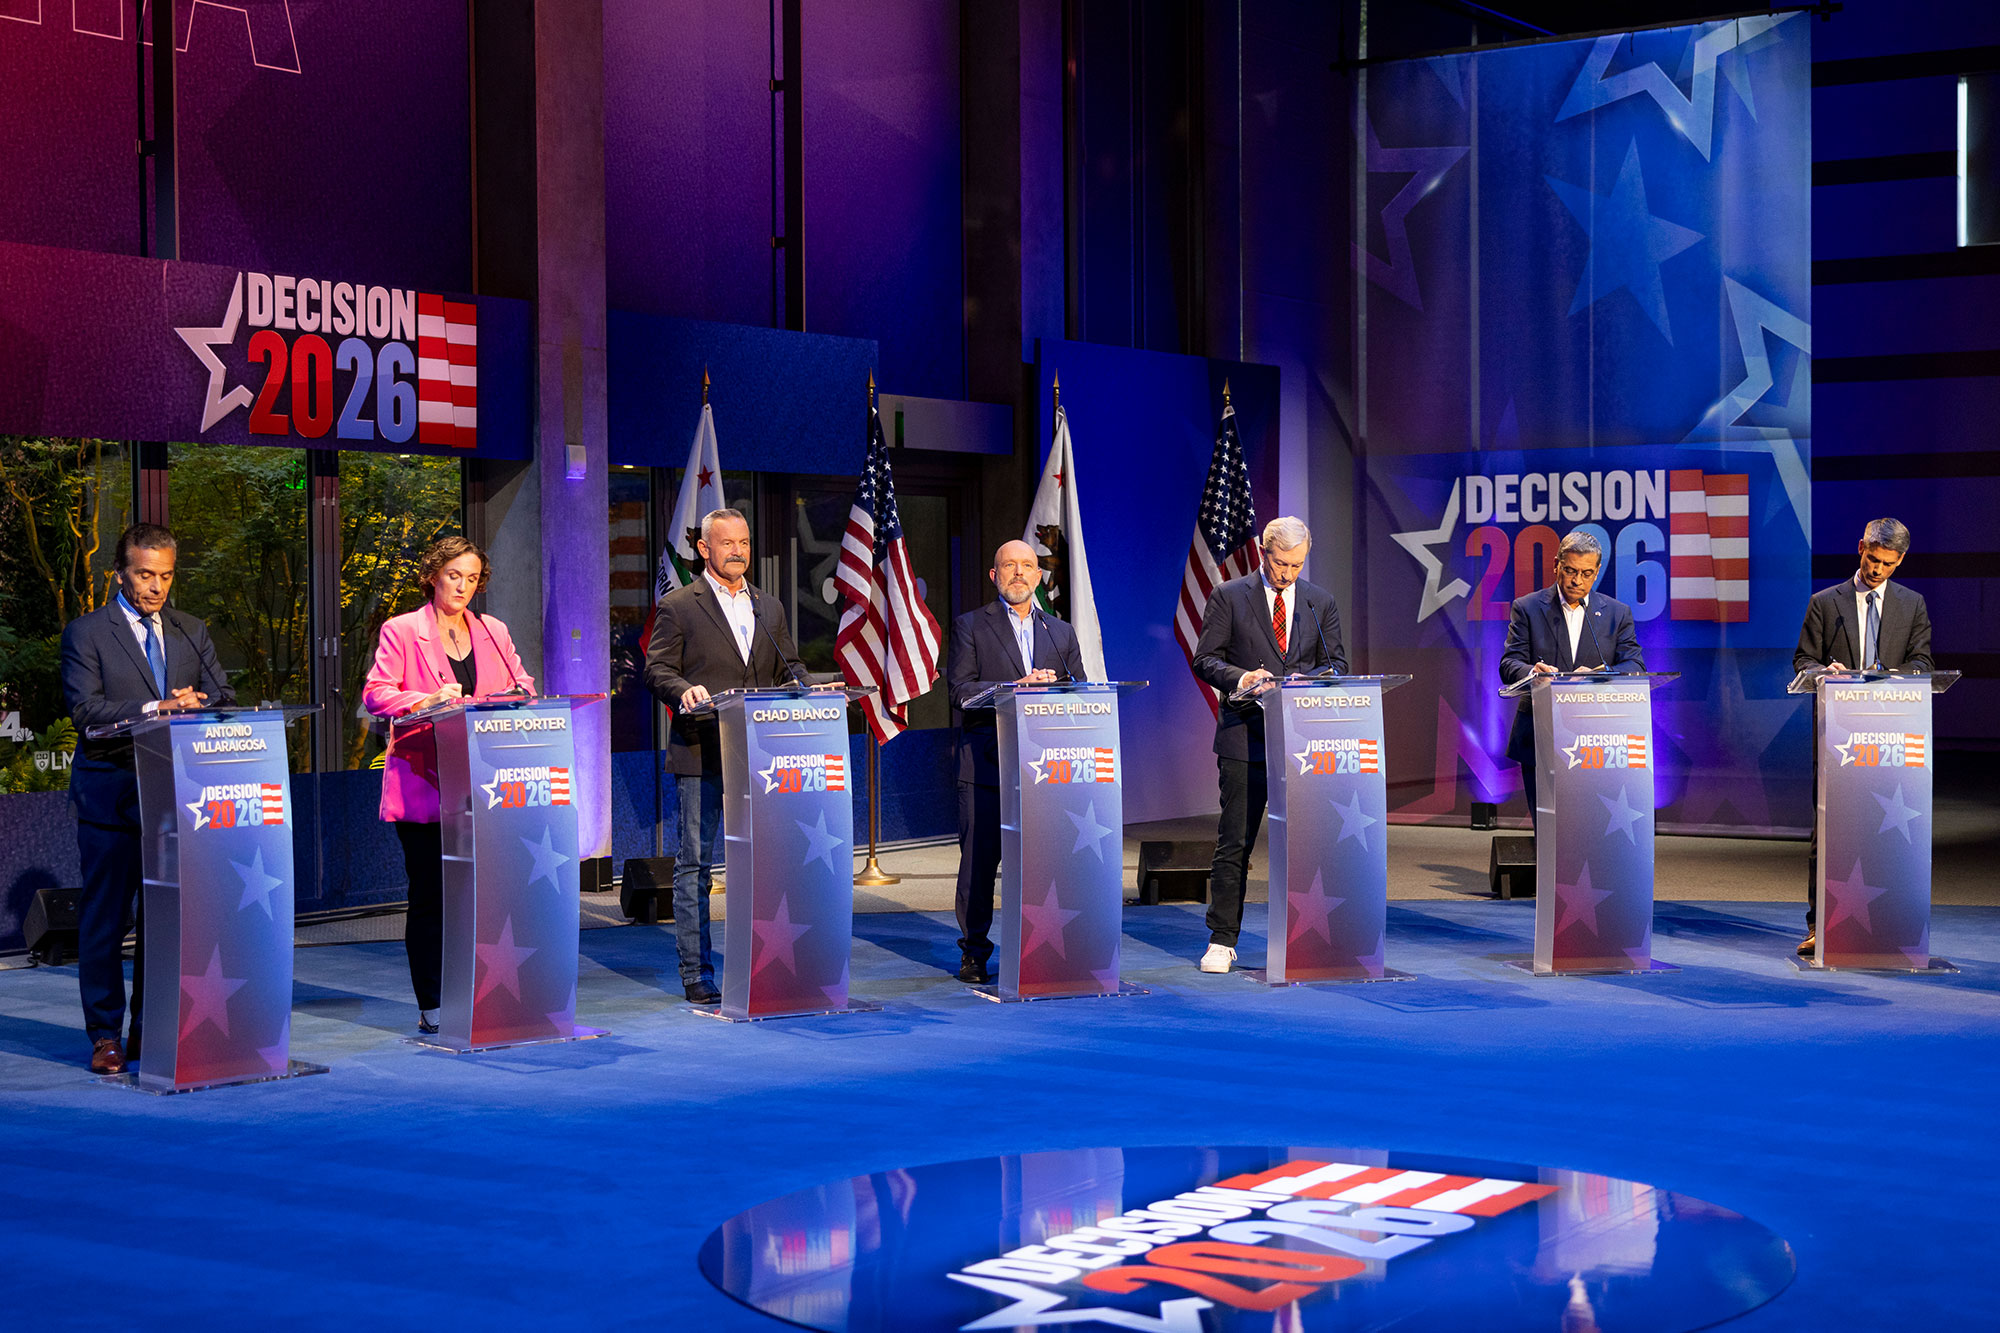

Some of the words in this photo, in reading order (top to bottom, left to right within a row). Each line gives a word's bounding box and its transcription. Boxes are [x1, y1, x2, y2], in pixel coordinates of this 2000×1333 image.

[248, 272, 416, 341] DECISION
[248, 330, 417, 443] 2026
[1465, 469, 1666, 524] DECISION
[1293, 696, 1321, 708] TOM
[1324, 695, 1371, 708] STEYER
[1555, 693, 1594, 703] XAVIER
[1596, 692, 1647, 703] BECERRA
[1834, 690, 1870, 701] MATT
[1873, 690, 1922, 701] MAHAN
[753, 709, 789, 722] CHAD
[792, 707, 840, 721] BIANCO
[1024, 703, 1064, 715] STEVE
[1066, 702, 1111, 715] HILTON
[205, 725, 252, 738] ANTONIO
[474, 718, 512, 733] KATIE
[514, 717, 566, 731] PORTER
[192, 738, 267, 754] VILLARAIGOSA
[1311, 739, 1359, 752] DECISION
[1580, 734, 1627, 746] DECISION
[1853, 732, 1904, 744] DECISION
[776, 754, 825, 769] DECISION
[1046, 747, 1095, 760] DECISION
[1580, 746, 1628, 769] 2026
[1853, 744, 1905, 767] 2026
[1046, 759, 1095, 784] 2026
[1311, 751, 1360, 775] 2026
[499, 766, 550, 783] DECISION
[776, 767, 826, 793] 2026
[206, 783, 261, 802] DECISION
[500, 780, 551, 809] 2026
[207, 797, 263, 829] 2026
[961, 1186, 1292, 1284] DECISION
[1082, 1200, 1475, 1311] 2026
